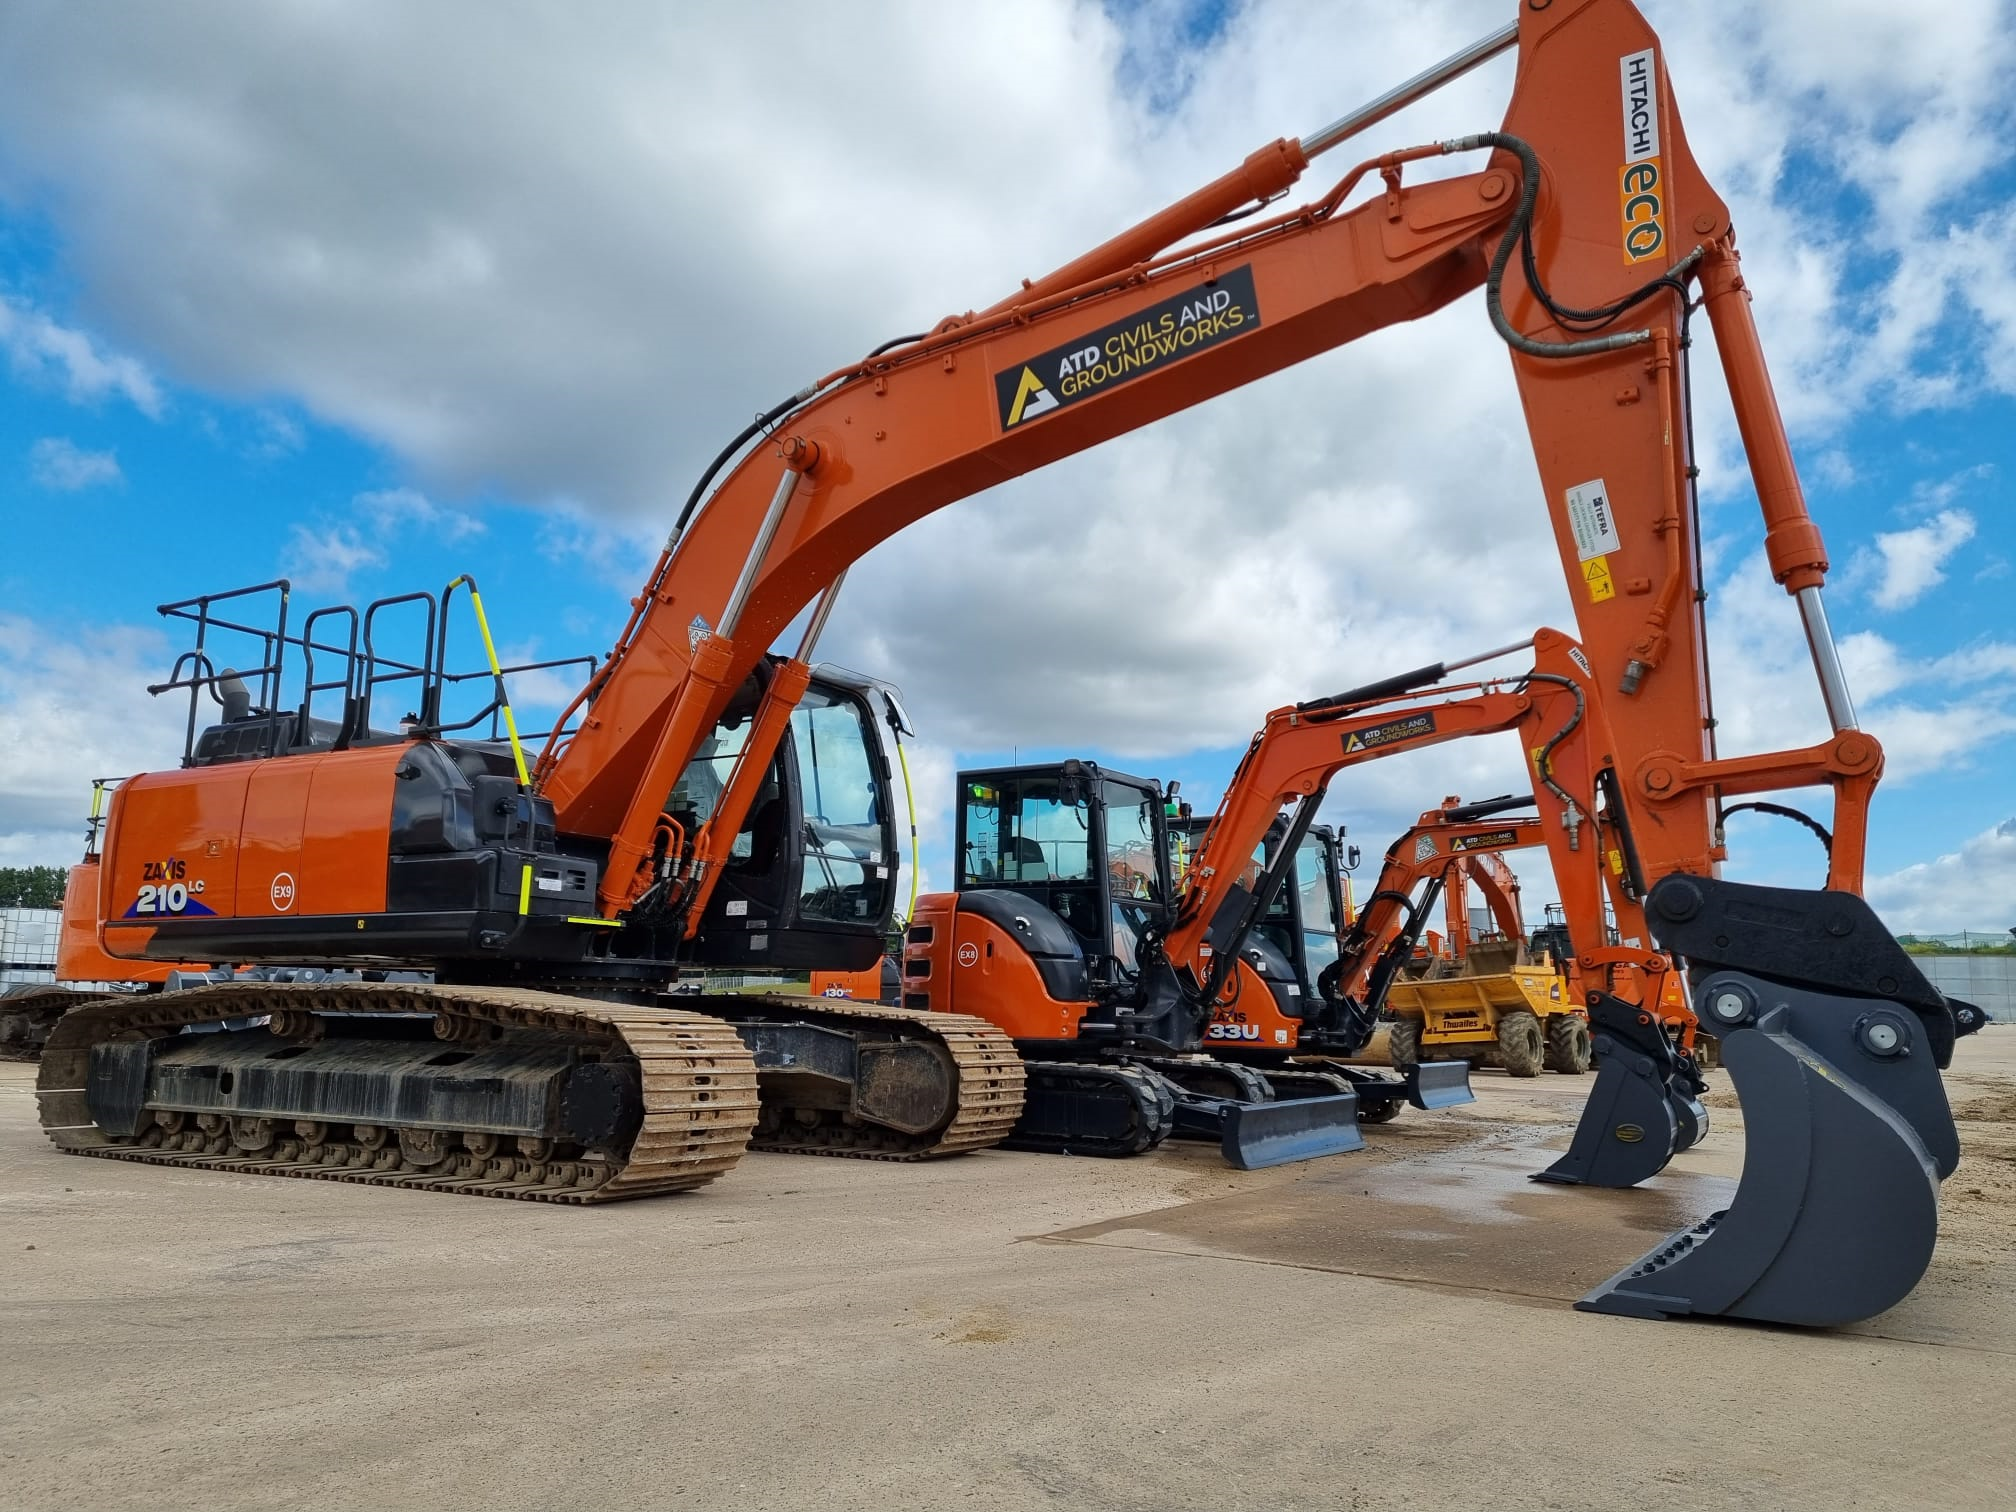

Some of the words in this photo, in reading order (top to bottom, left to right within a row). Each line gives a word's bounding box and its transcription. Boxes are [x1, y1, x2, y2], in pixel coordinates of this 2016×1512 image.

[1628, 56, 1651, 155] HITACHI
[1622, 162, 1664, 262] eco
[1058, 345, 1101, 379] ATD
[1104, 313, 1176, 357] CIVILS
[1179, 289, 1231, 328] AND
[1060, 305, 1244, 397] GROUNDWORKS
[1595, 505, 1609, 537] TEFRA
[1364, 729, 1381, 740] ATD
[1381, 722, 1408, 736] CIVILS
[1408, 717, 1427, 729] AND
[1365, 723, 1432, 747] GROUNDWORKS
[1498, 832, 1511, 840] AND
[143, 857, 186, 881] ZAXIS
[136, 883, 188, 913] 210
[273, 886, 292, 899] EX9
[960, 950, 976, 959] EX8
[825, 988, 844, 998] 130
[1208, 1023, 1260, 1040] 33U
[1443, 1019, 1479, 1029] Thwaites
